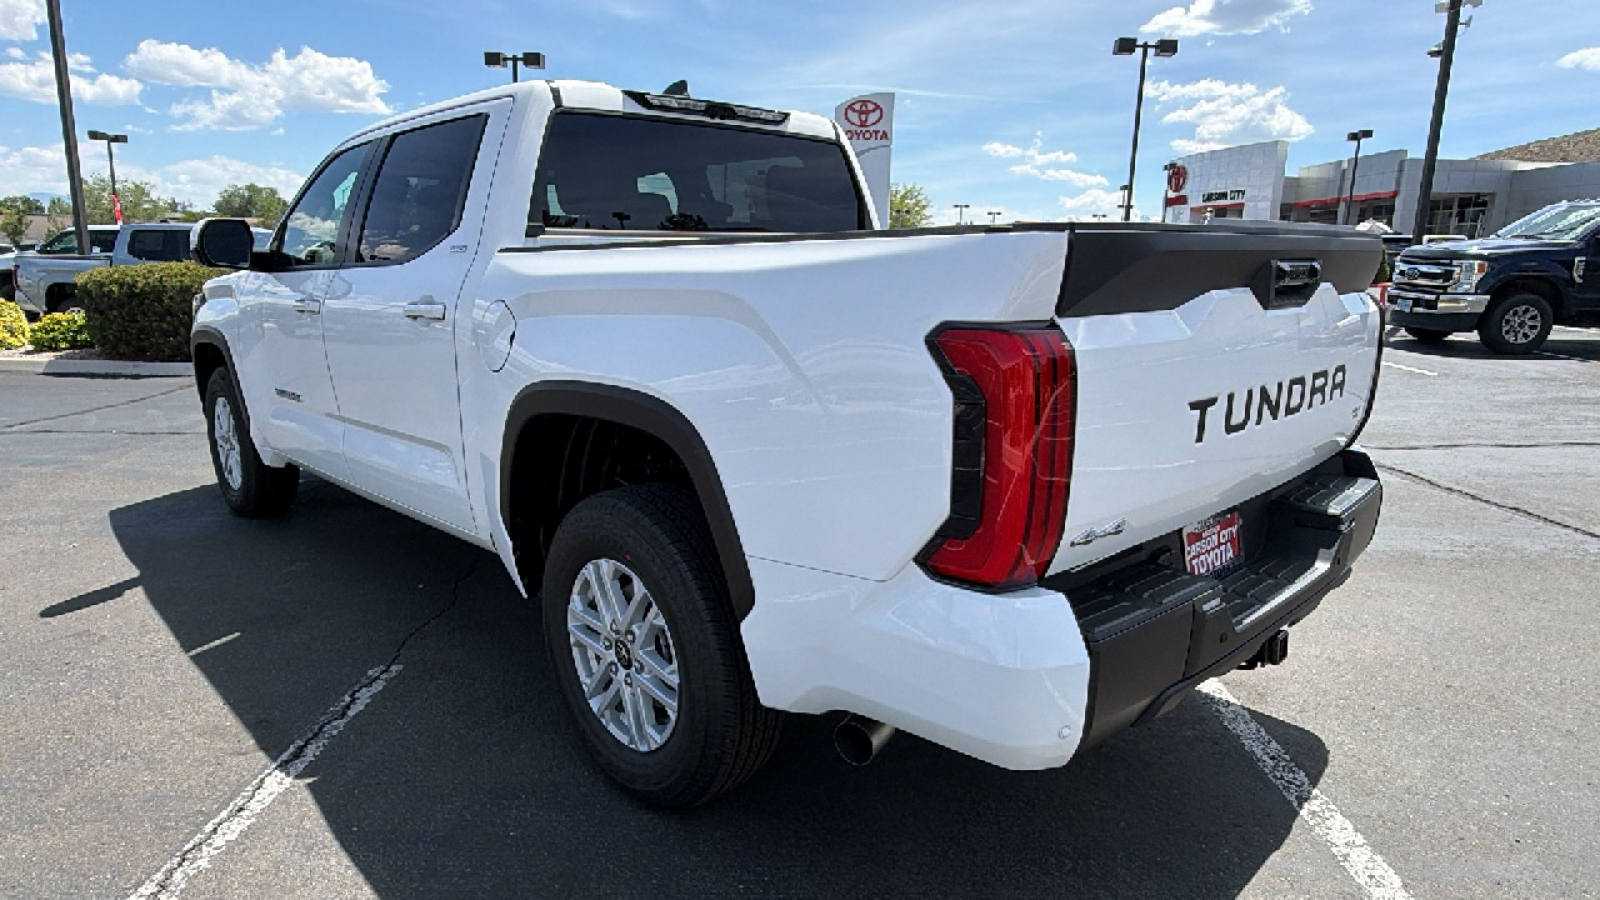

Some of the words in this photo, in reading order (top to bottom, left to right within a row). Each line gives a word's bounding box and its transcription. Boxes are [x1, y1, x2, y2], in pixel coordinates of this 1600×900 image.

[845, 129, 889, 141] OYOTA
[1229, 189, 1245, 201] CITY
[1187, 364, 1346, 443] TUNDRA
[1186, 533, 1218, 560] CARSON
[1219, 524, 1238, 543] CITY
[1191, 542, 1234, 576] TOYOTA
